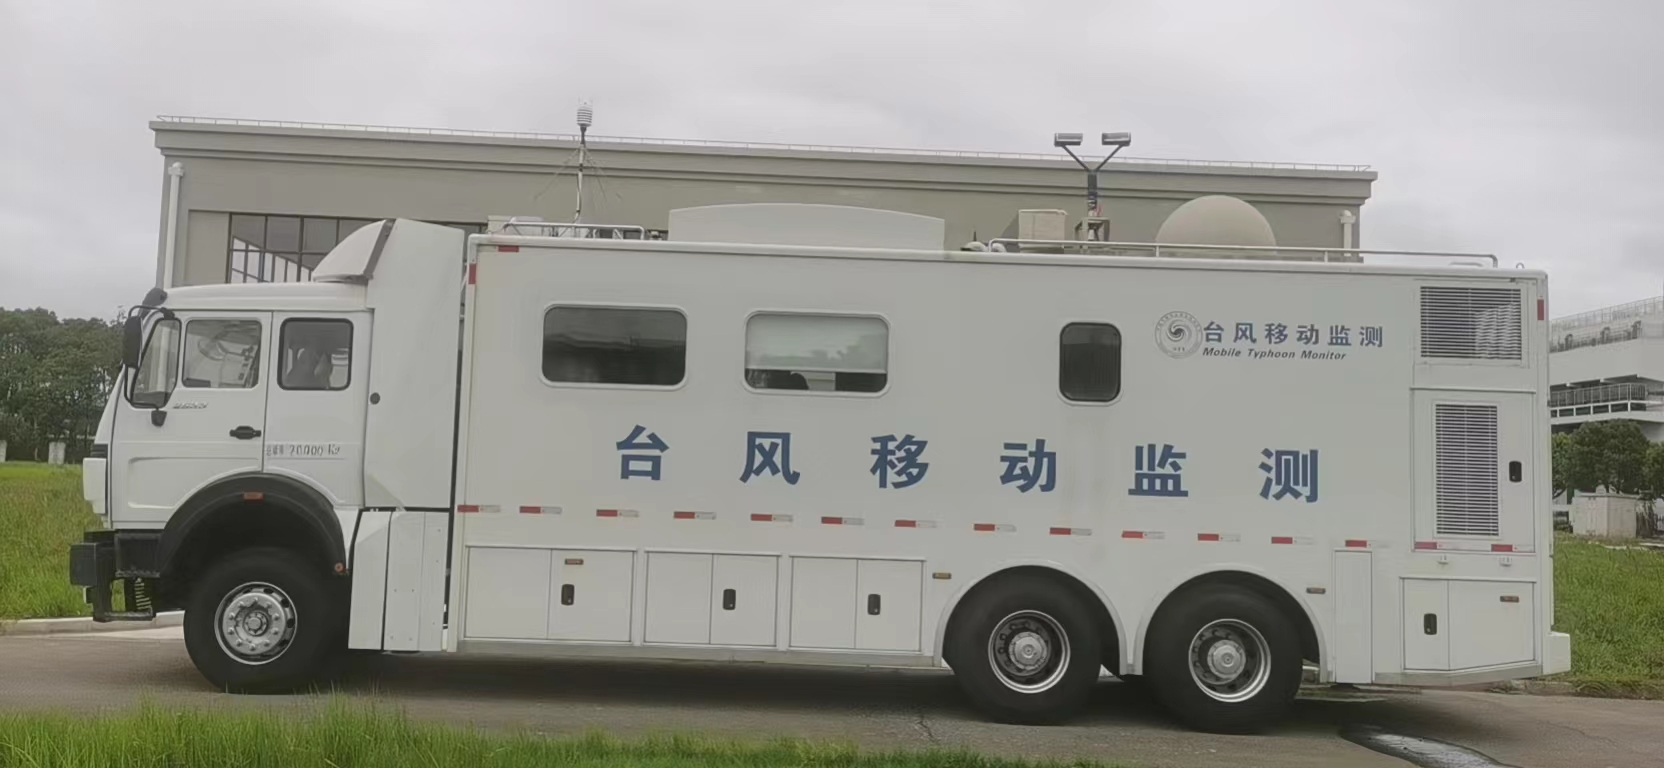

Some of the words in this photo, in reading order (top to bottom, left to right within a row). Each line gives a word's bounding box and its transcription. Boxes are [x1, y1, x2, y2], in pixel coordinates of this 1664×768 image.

[1203, 321, 1383, 348] 台风移动监测
[1202, 347, 1241, 357] Mobile
[1247, 348, 1296, 360] Typhoon
[1300, 350, 1346, 360] Monitor
[616, 425, 1319, 503] 台风移动监测
